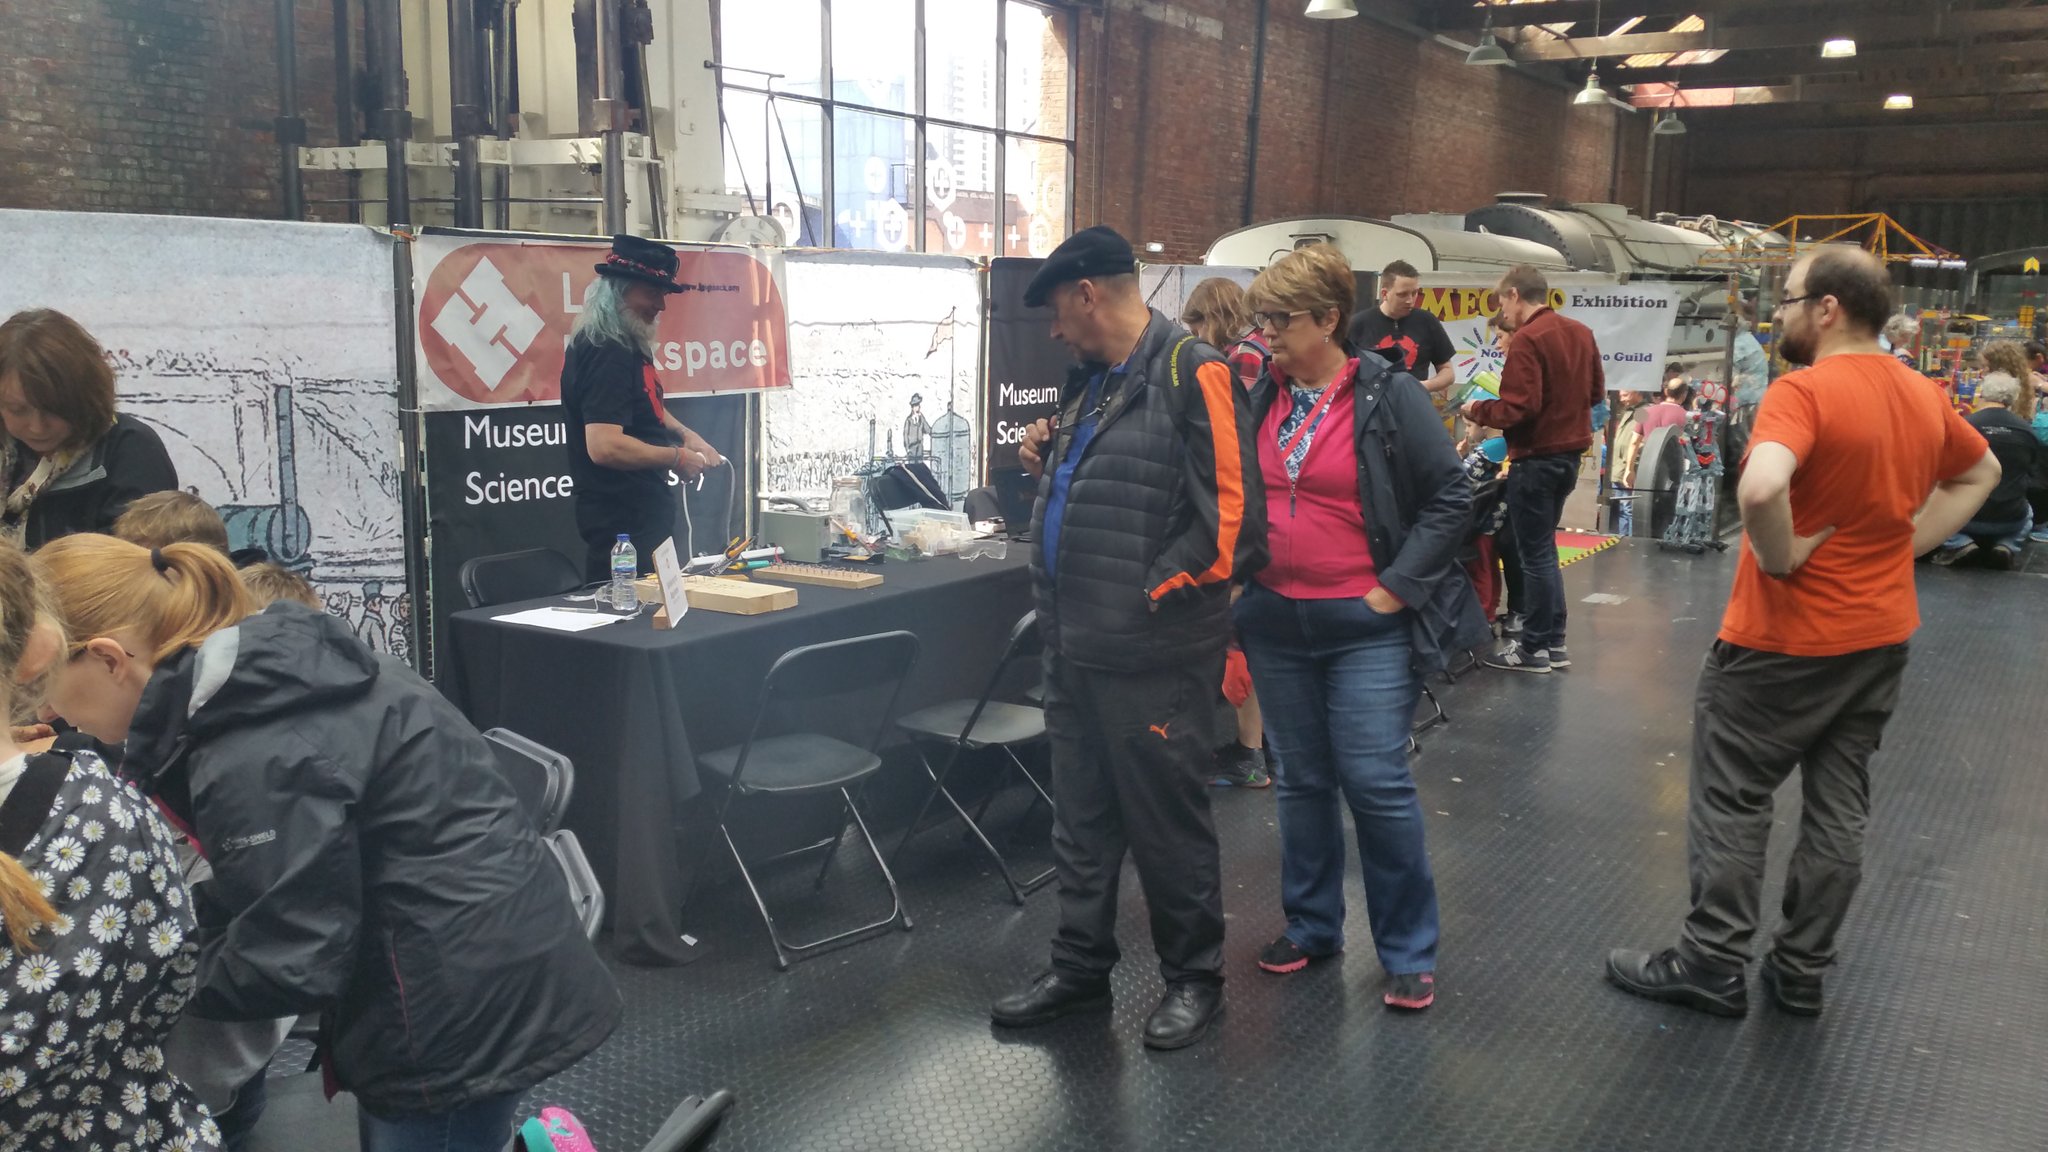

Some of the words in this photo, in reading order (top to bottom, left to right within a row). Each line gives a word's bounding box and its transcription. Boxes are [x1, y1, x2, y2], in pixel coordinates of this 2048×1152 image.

[1572, 295, 1668, 308] Exhibition
[1613, 352, 1652, 362] Guild
[999, 383, 1058, 407] Museum
[464, 415, 567, 449] Museu
[996, 421, 1027, 445] Scie
[465, 471, 574, 505] Science
